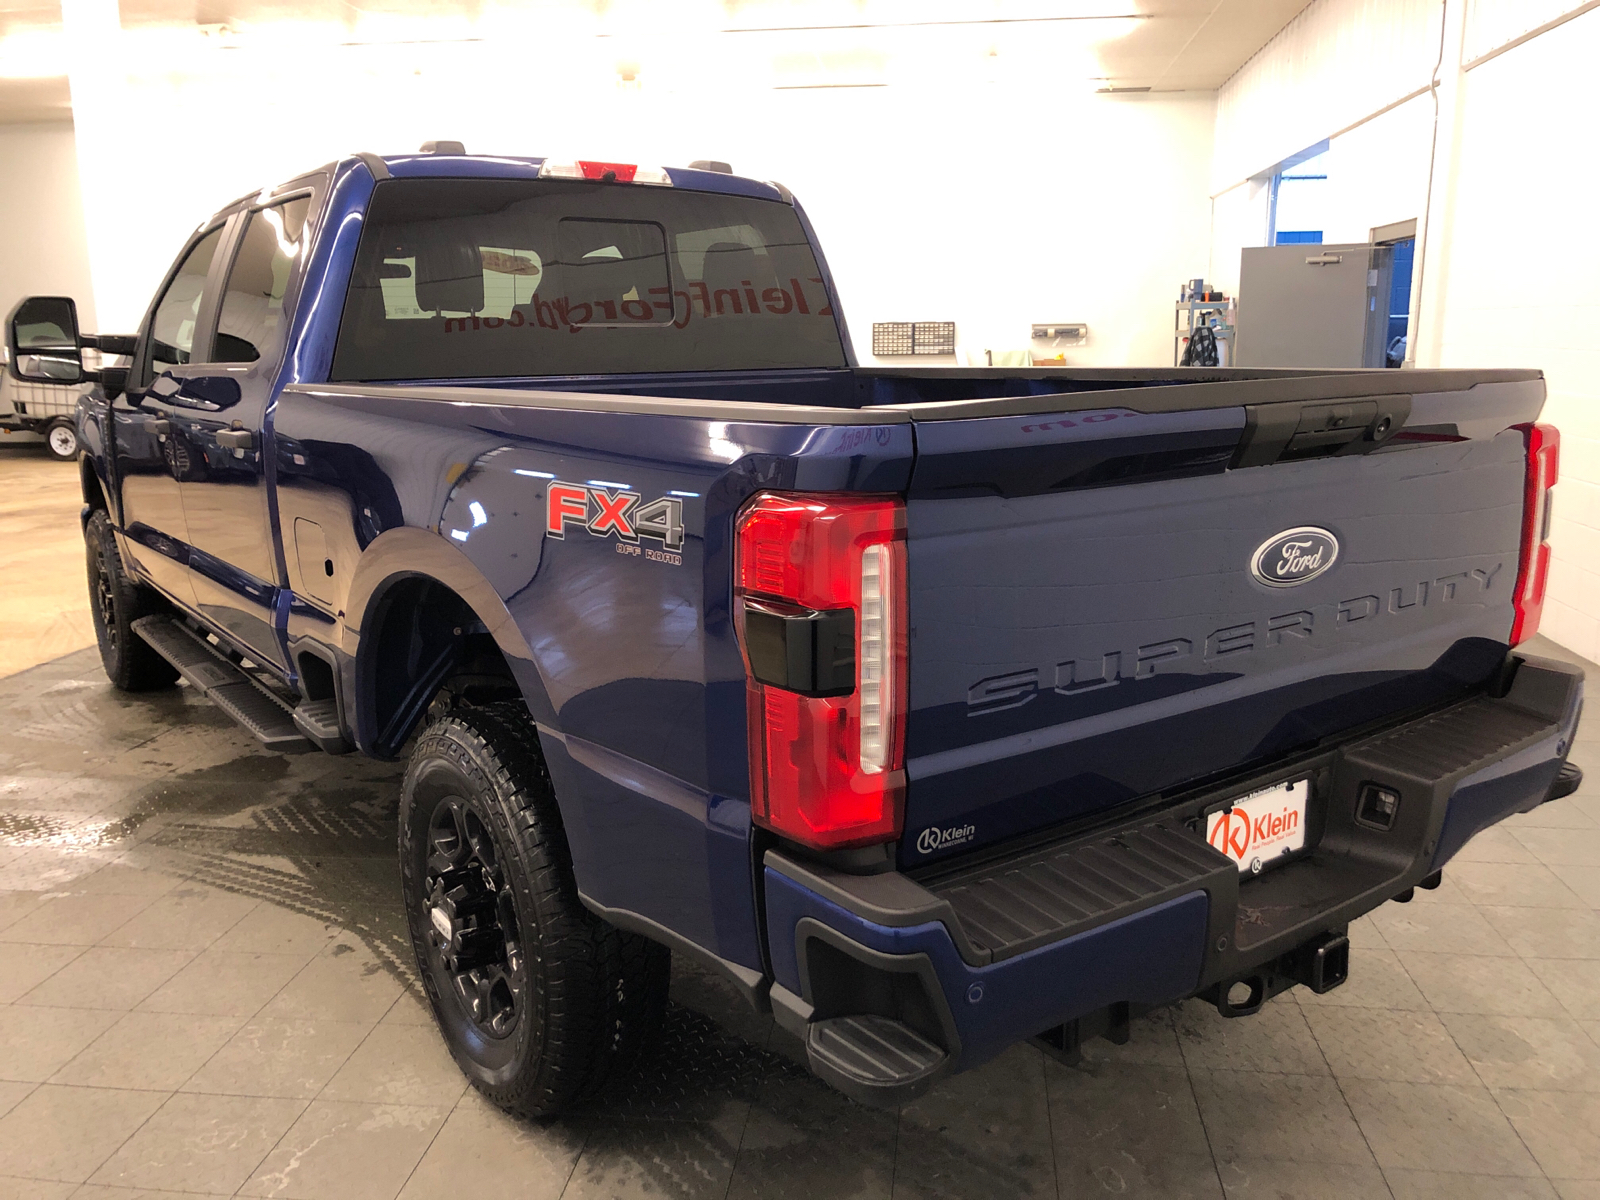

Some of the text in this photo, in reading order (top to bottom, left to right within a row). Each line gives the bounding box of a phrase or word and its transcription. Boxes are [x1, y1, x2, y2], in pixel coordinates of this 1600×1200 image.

[546, 480, 685, 552] FX4
[616, 542, 682, 566] OFF ROAD
[1276, 540, 1324, 575] Ford
[967, 562, 1502, 717] SUPER DUTY
[942, 824, 975, 842] Klein
[1252, 806, 1299, 844] Klein
